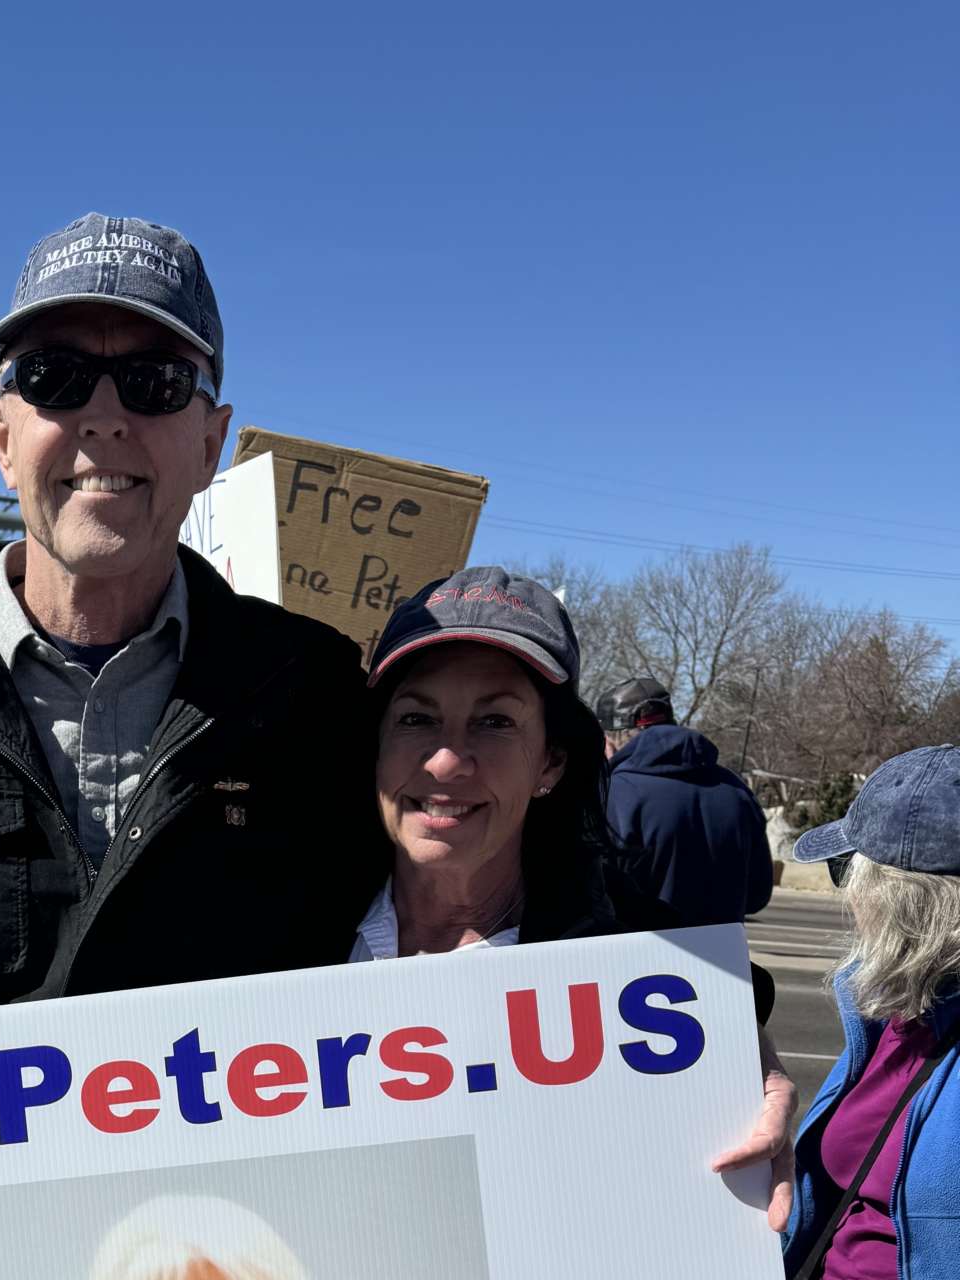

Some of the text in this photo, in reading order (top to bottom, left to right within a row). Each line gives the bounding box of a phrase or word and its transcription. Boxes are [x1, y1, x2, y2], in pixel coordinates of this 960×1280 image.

[36, 250, 182, 284] HEALTHY AGAIN
[43, 233, 179, 267] MAKE AMERICA
[286, 460, 422, 538] Free
